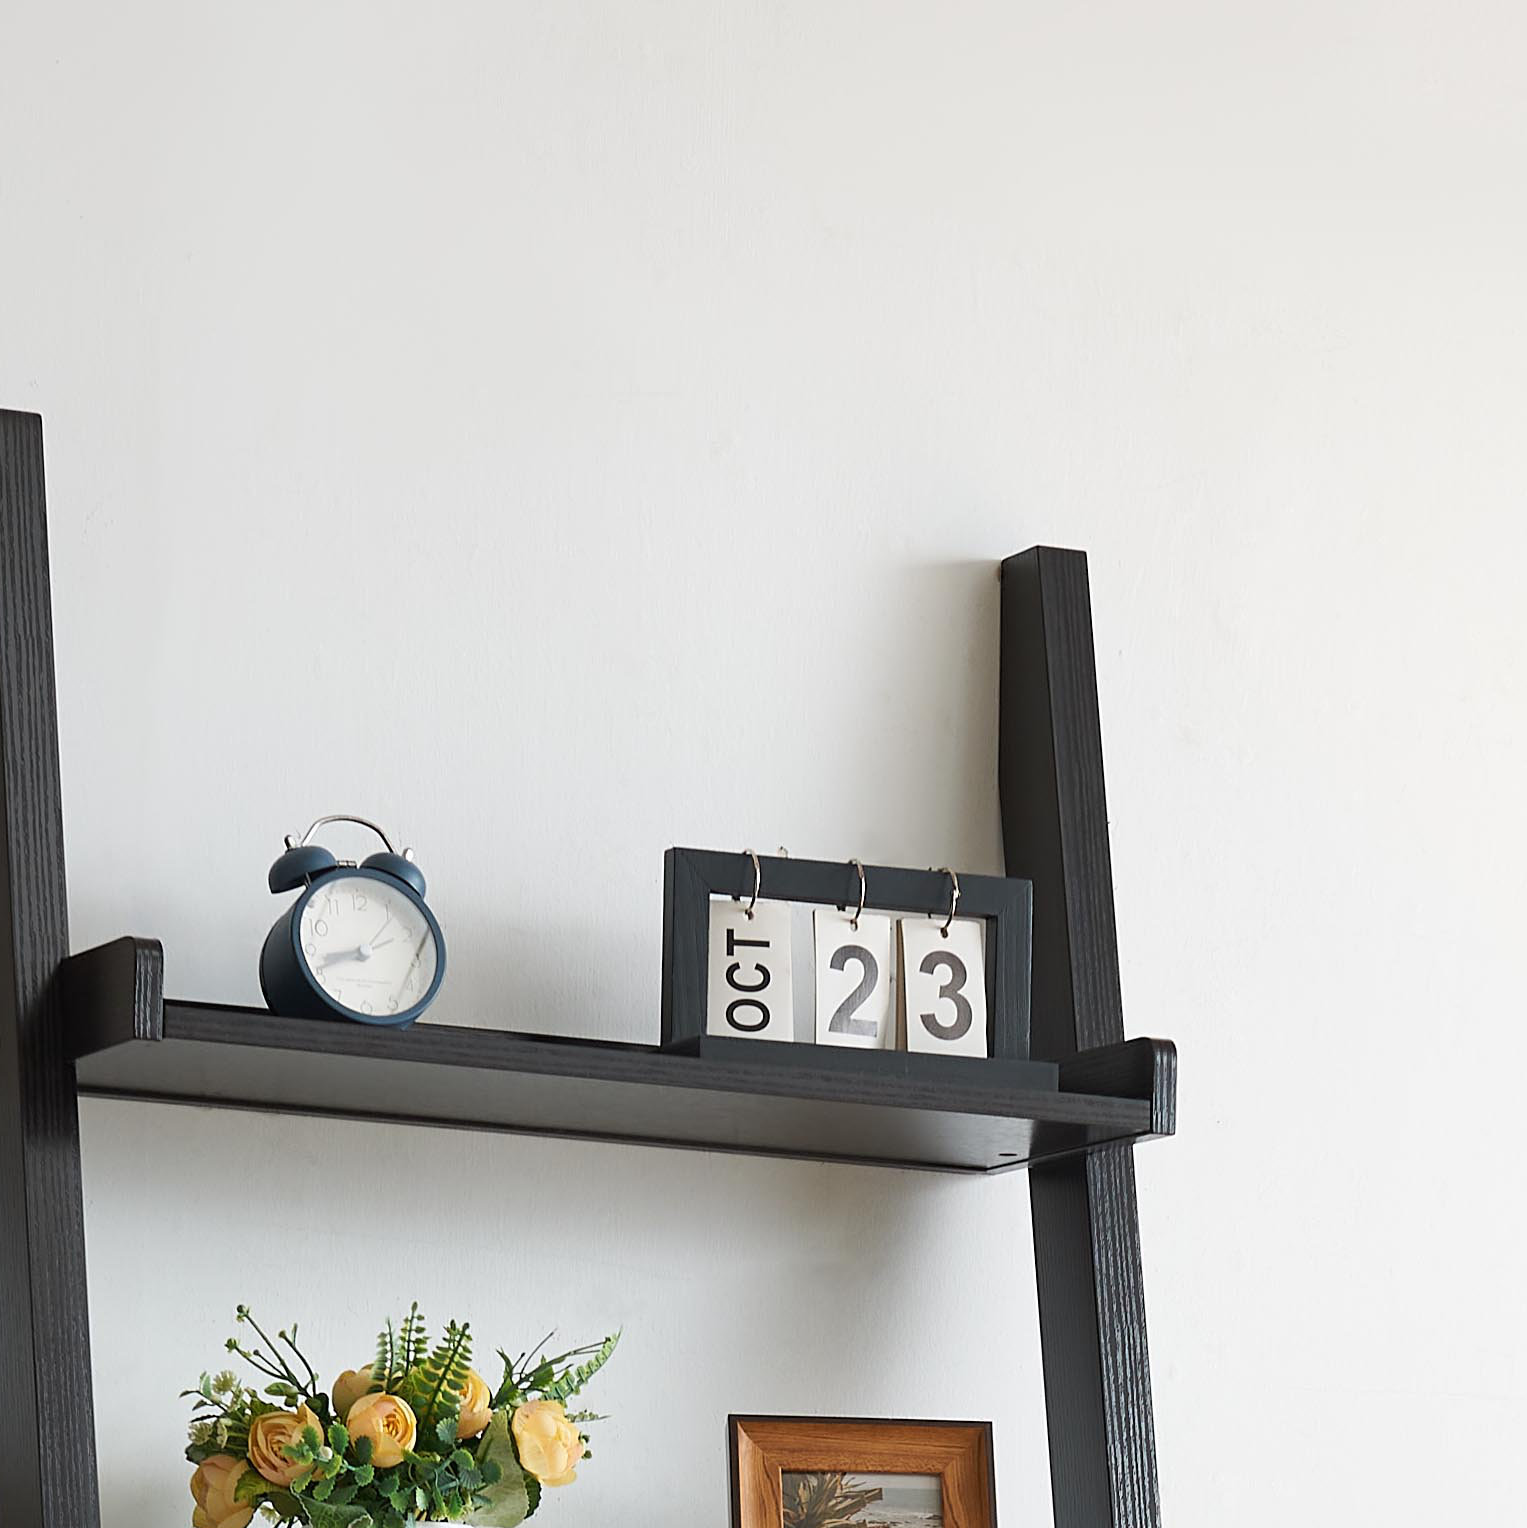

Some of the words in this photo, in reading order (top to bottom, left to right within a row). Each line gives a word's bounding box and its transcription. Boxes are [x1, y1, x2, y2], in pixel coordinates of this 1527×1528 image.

[309, 918, 329, 937] 10
[351, 894, 368, 912] 12
[725, 927, 771, 1033] OCT
[827, 944, 880, 1038] 2
[918, 950, 974, 1042] 3
